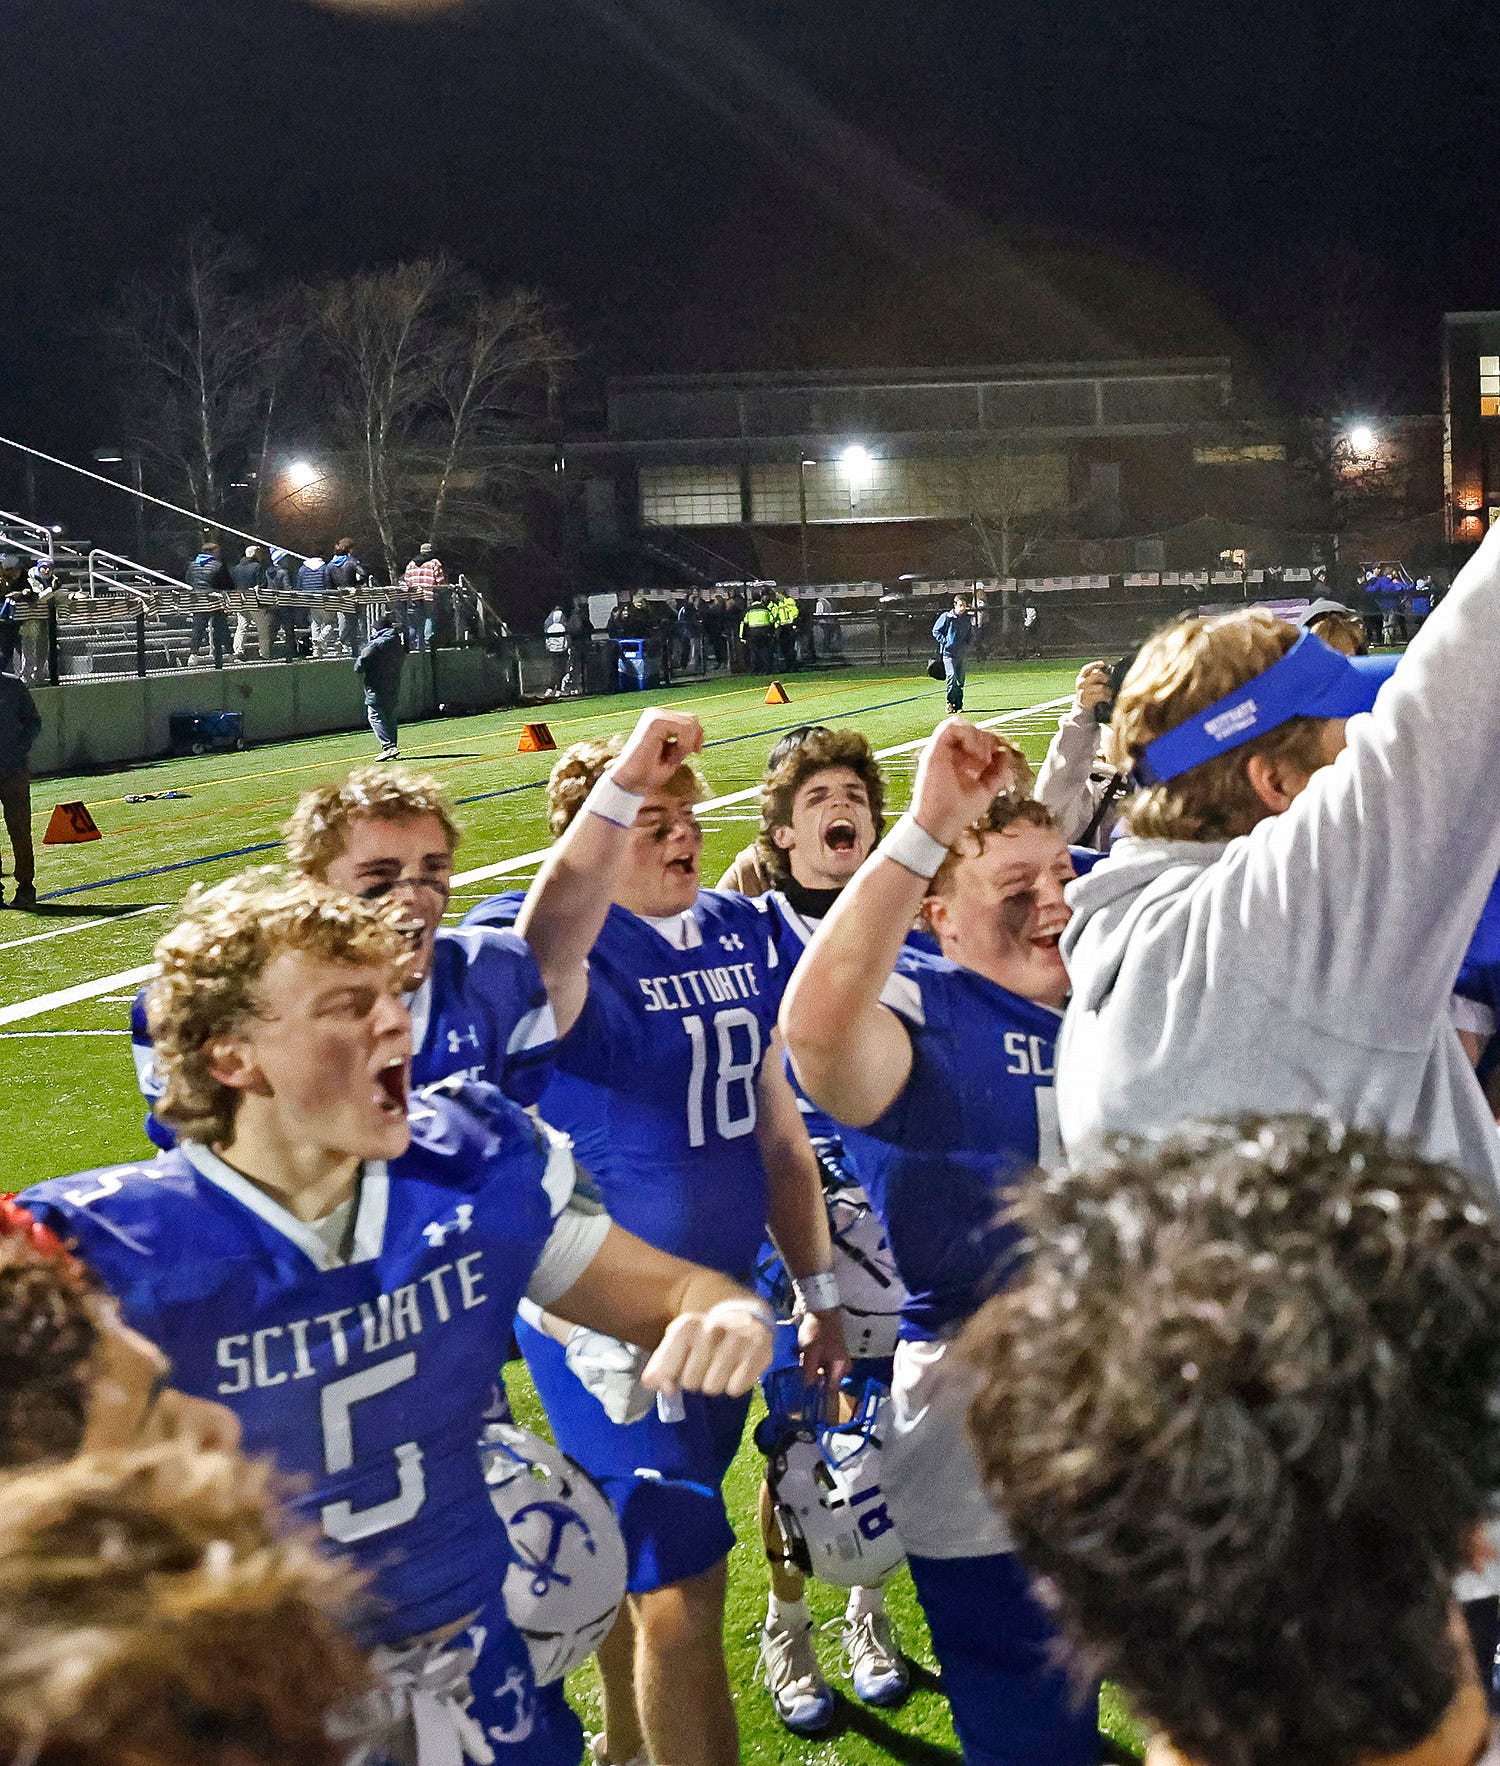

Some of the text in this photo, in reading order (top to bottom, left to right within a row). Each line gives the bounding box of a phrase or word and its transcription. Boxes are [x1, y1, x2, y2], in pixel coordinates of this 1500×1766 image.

[638, 962, 761, 1011] SCITUATE
[681, 1006, 762, 1148] 18
[216, 1250, 489, 1395] SCITUATE
[320, 1351, 427, 1544] 5
